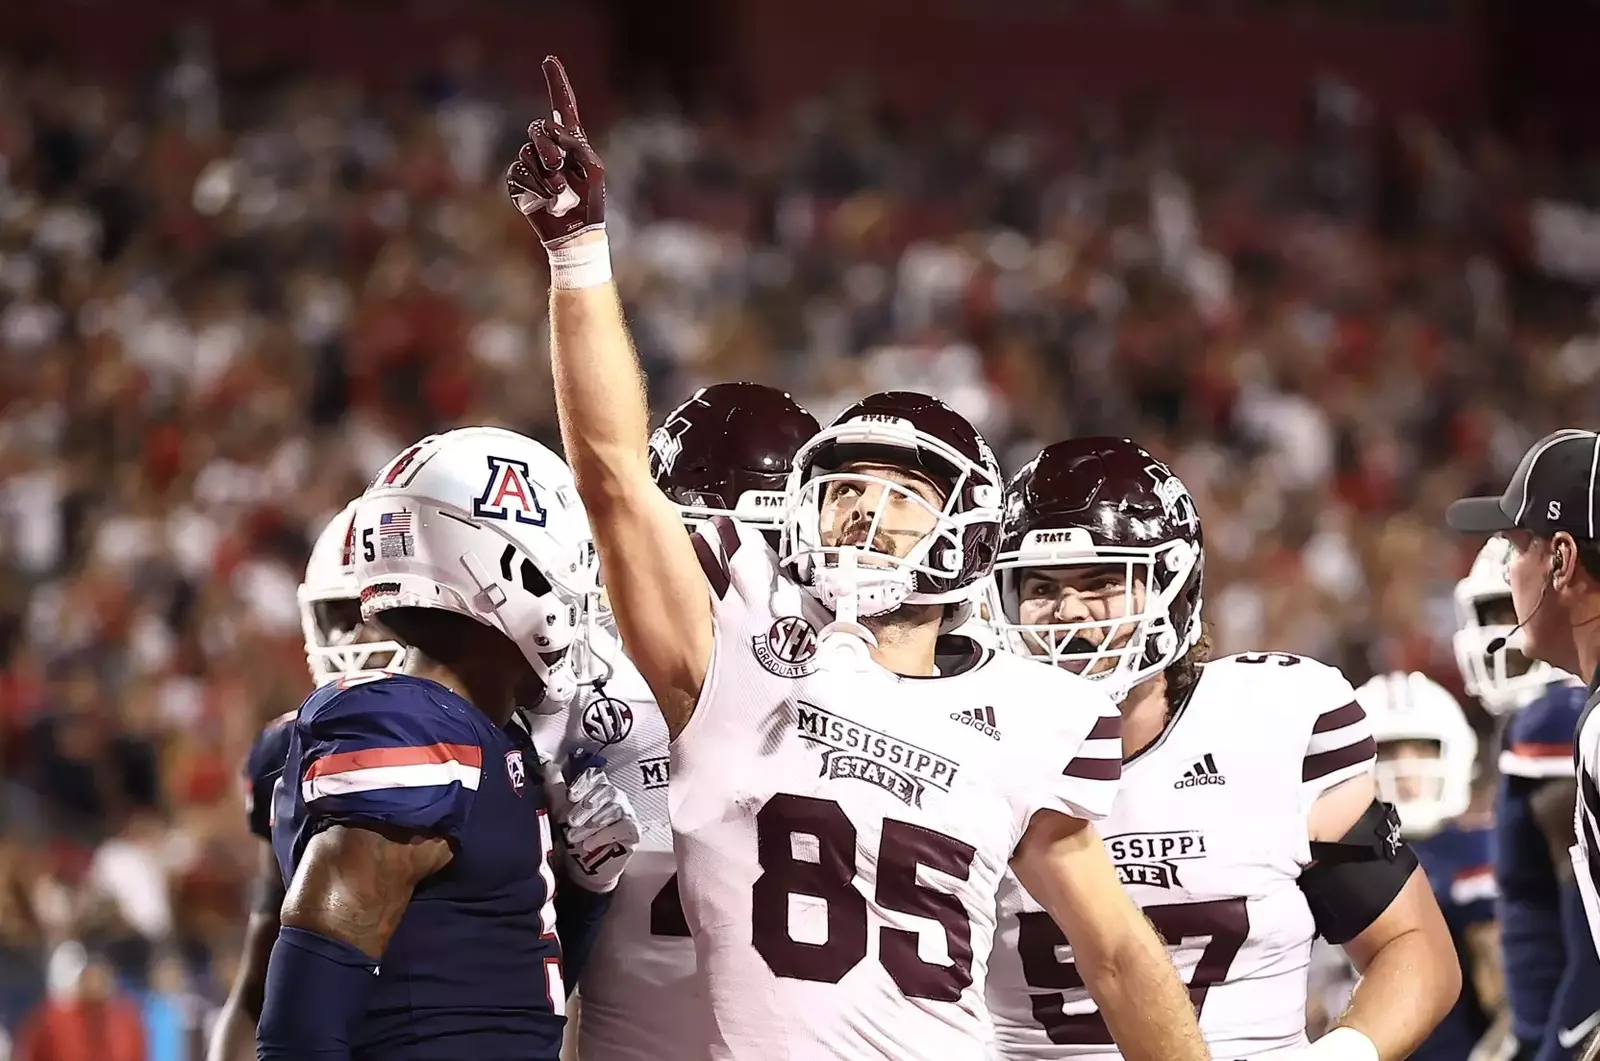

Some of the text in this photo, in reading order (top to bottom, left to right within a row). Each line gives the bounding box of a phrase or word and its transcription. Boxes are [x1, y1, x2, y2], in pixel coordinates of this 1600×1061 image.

[473, 455, 547, 527] A
[755, 495, 785, 507] STAT
[1547, 500, 1561, 520] S
[362, 528, 376, 562] 5
[1035, 531, 1072, 543] STATE
[757, 646, 809, 676] GRADUATE
[582, 697, 633, 744] SEC
[949, 712, 1002, 742] adidas
[797, 708, 958, 788] MISSISSIPPI
[640, 761, 669, 785] MI
[836, 757, 908, 804] STATE
[1173, 773, 1226, 790] adidas
[1111, 836, 1207, 861] SSIPPI
[1116, 864, 1163, 886] ATE
[752, 792, 977, 1002] 85
